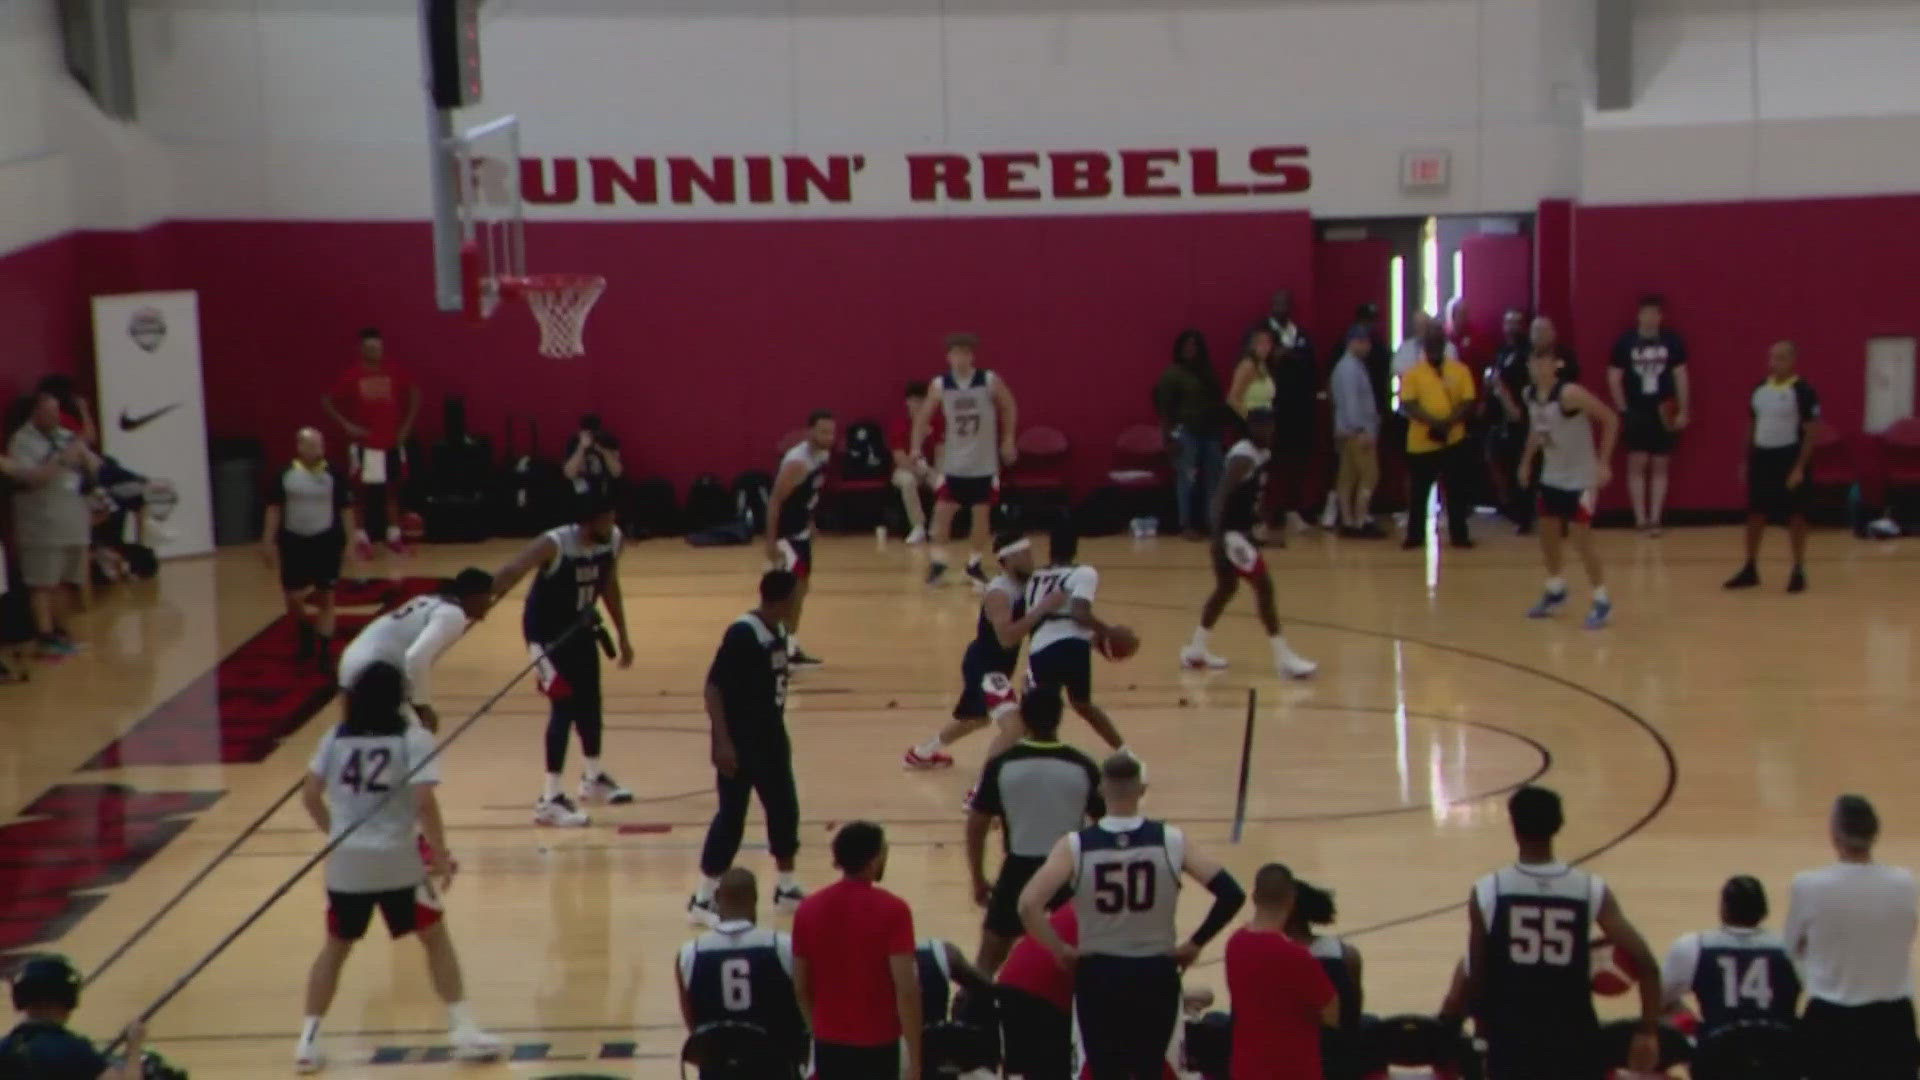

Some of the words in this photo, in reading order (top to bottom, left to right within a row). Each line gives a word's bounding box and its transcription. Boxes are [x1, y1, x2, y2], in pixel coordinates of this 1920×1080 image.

[906, 146, 1311, 201] REBELS
[955, 414, 980, 436] 27
[341, 747, 391, 795] 42
[1094, 861, 1155, 914] 50
[1508, 905, 1576, 966] 55
[720, 958, 752, 1012] 6
[1716, 955, 1774, 1010] 14
